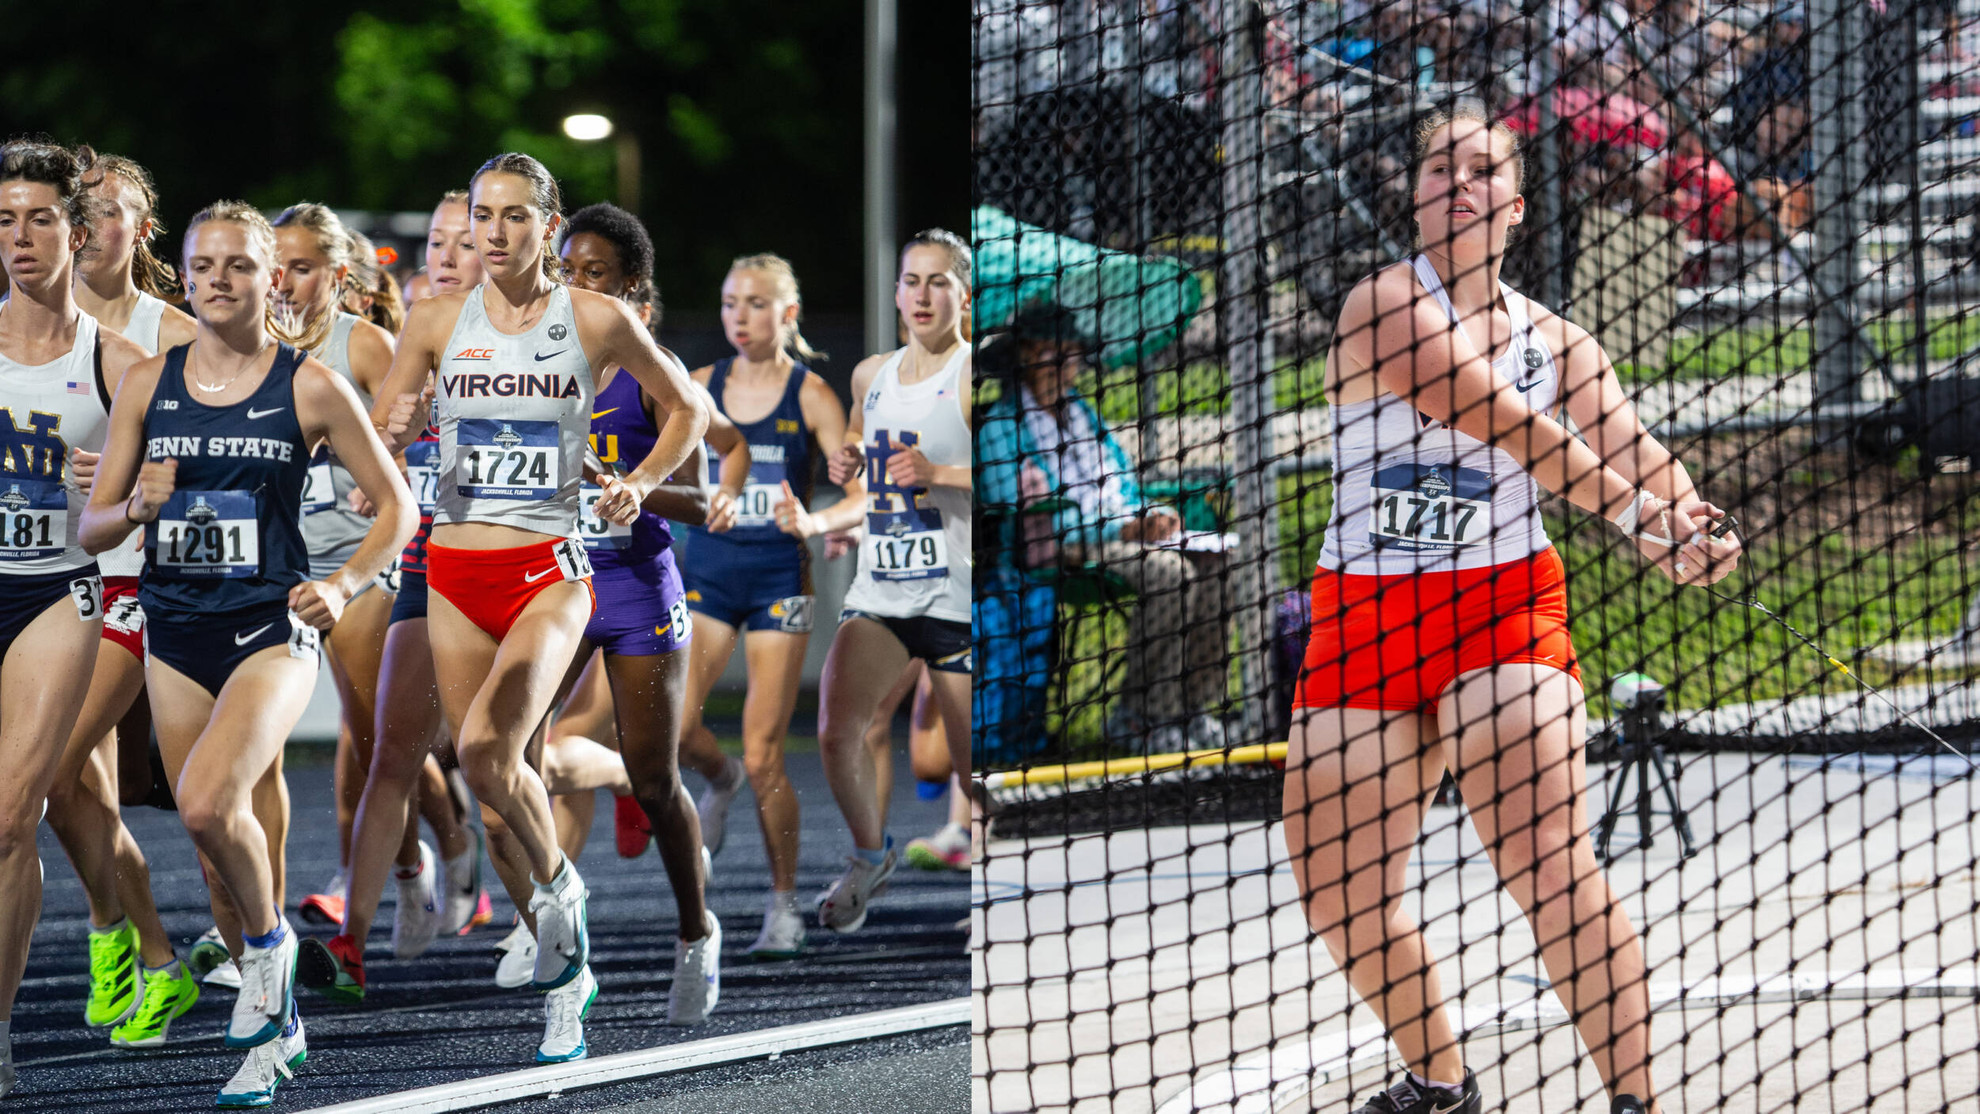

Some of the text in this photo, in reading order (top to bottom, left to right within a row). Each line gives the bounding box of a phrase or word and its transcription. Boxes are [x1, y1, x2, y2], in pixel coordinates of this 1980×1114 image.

[456, 348, 496, 358] ACC
[442, 373, 582, 400] VIRGINIA
[208, 437, 294, 463] STATE
[468, 450, 549, 486] 1724
[1383, 496, 1478, 542] 1717
[167, 525, 246, 564] 1291
[875, 536, 937, 570] 1179
